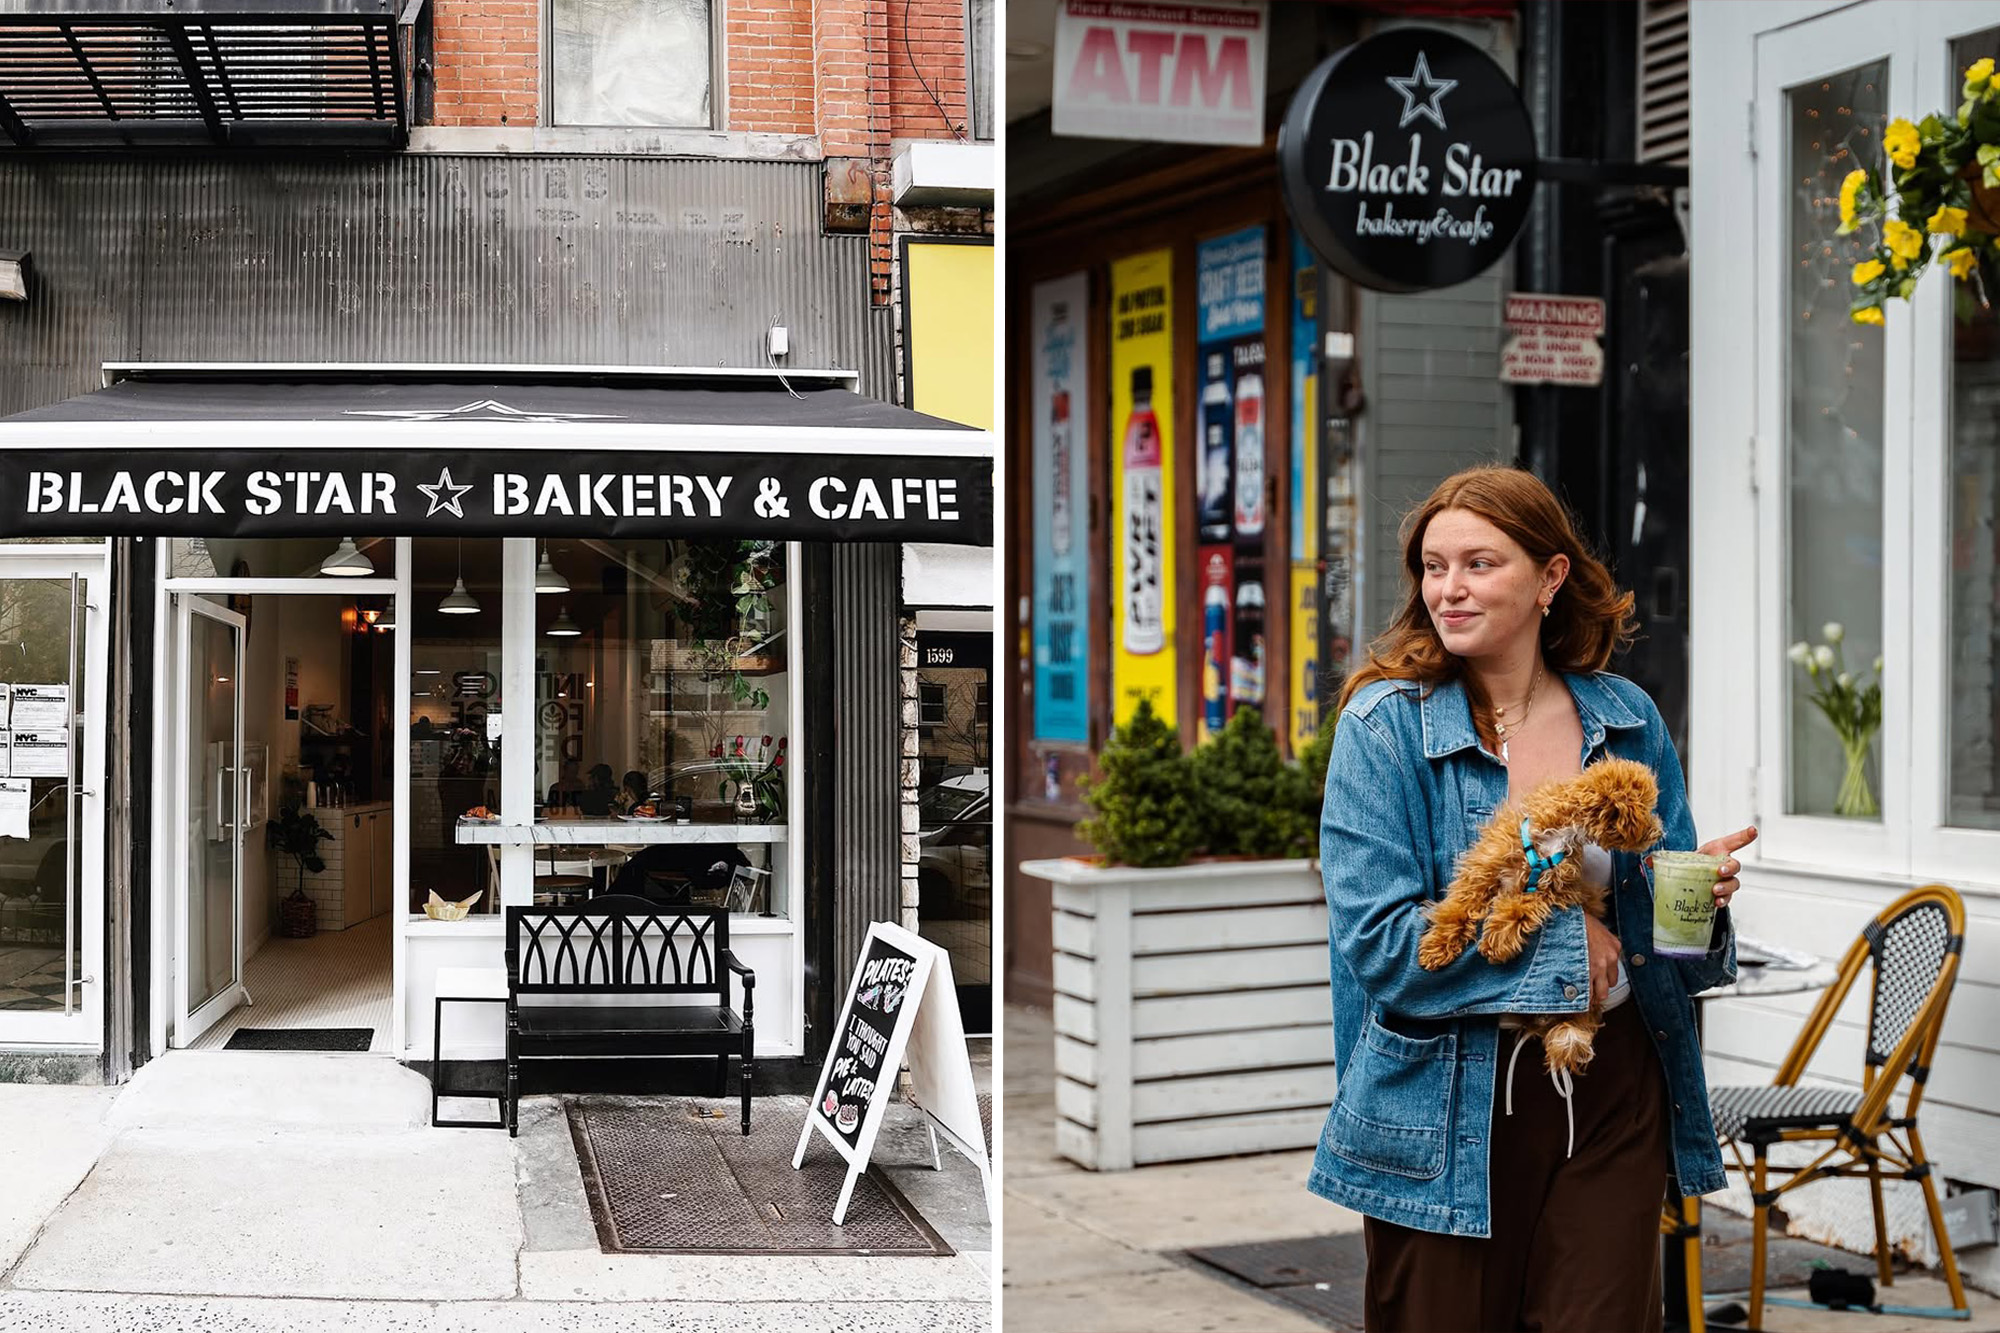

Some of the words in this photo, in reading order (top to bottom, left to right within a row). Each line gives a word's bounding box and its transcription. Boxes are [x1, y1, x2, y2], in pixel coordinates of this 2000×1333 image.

[1066, 27, 1254, 110] ATM
[1325, 131, 1430, 195] Black
[1442, 142, 1522, 196] Star
[1506, 303, 1598, 324] WARNING
[26, 471, 227, 514] BLACK
[244, 471, 398, 515] STAR
[493, 473, 733, 517] BAKERY
[753, 477, 791, 519] &
[808, 476, 960, 520] CAFE
[926, 648, 954, 663] 1599
[16, 688, 37, 696] NYC
[1673, 899, 1700, 913] Black
[848, 1013, 858, 1031] I
[855, 1018, 888, 1055] THOUGHT
[846, 1032, 862, 1055] YOU
[860, 1044, 877, 1069] SAID
[830, 1057, 854, 1082] PIE
[850, 1060, 858, 1075] &
